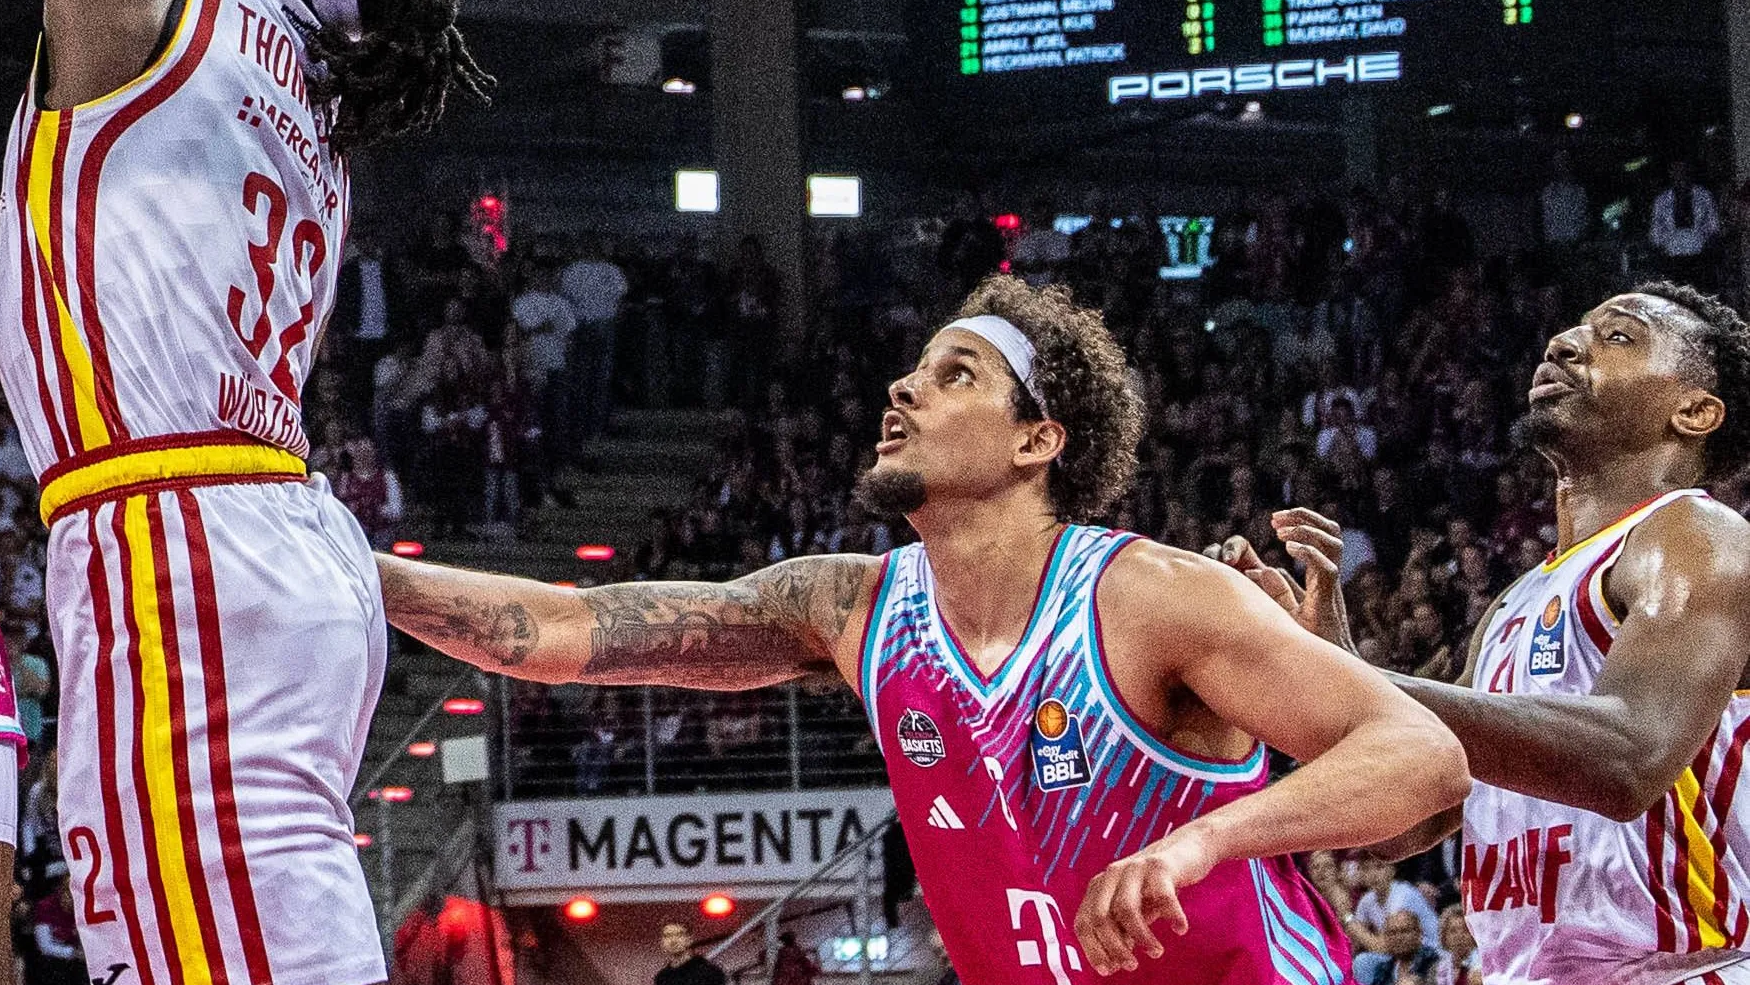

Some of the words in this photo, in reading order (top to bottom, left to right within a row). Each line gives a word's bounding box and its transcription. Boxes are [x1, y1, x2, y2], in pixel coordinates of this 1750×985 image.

[1109, 52, 1401, 104] PORSCHE
[227, 171, 327, 408] 32
[1531, 651, 1562, 670] BBL
[900, 738, 943, 754] BASKETS
[1043, 760, 1084, 784] BBL
[567, 808, 872, 872] MAGENTA
[68, 826, 117, 925] 2
[1461, 822, 1573, 925] NAUF
